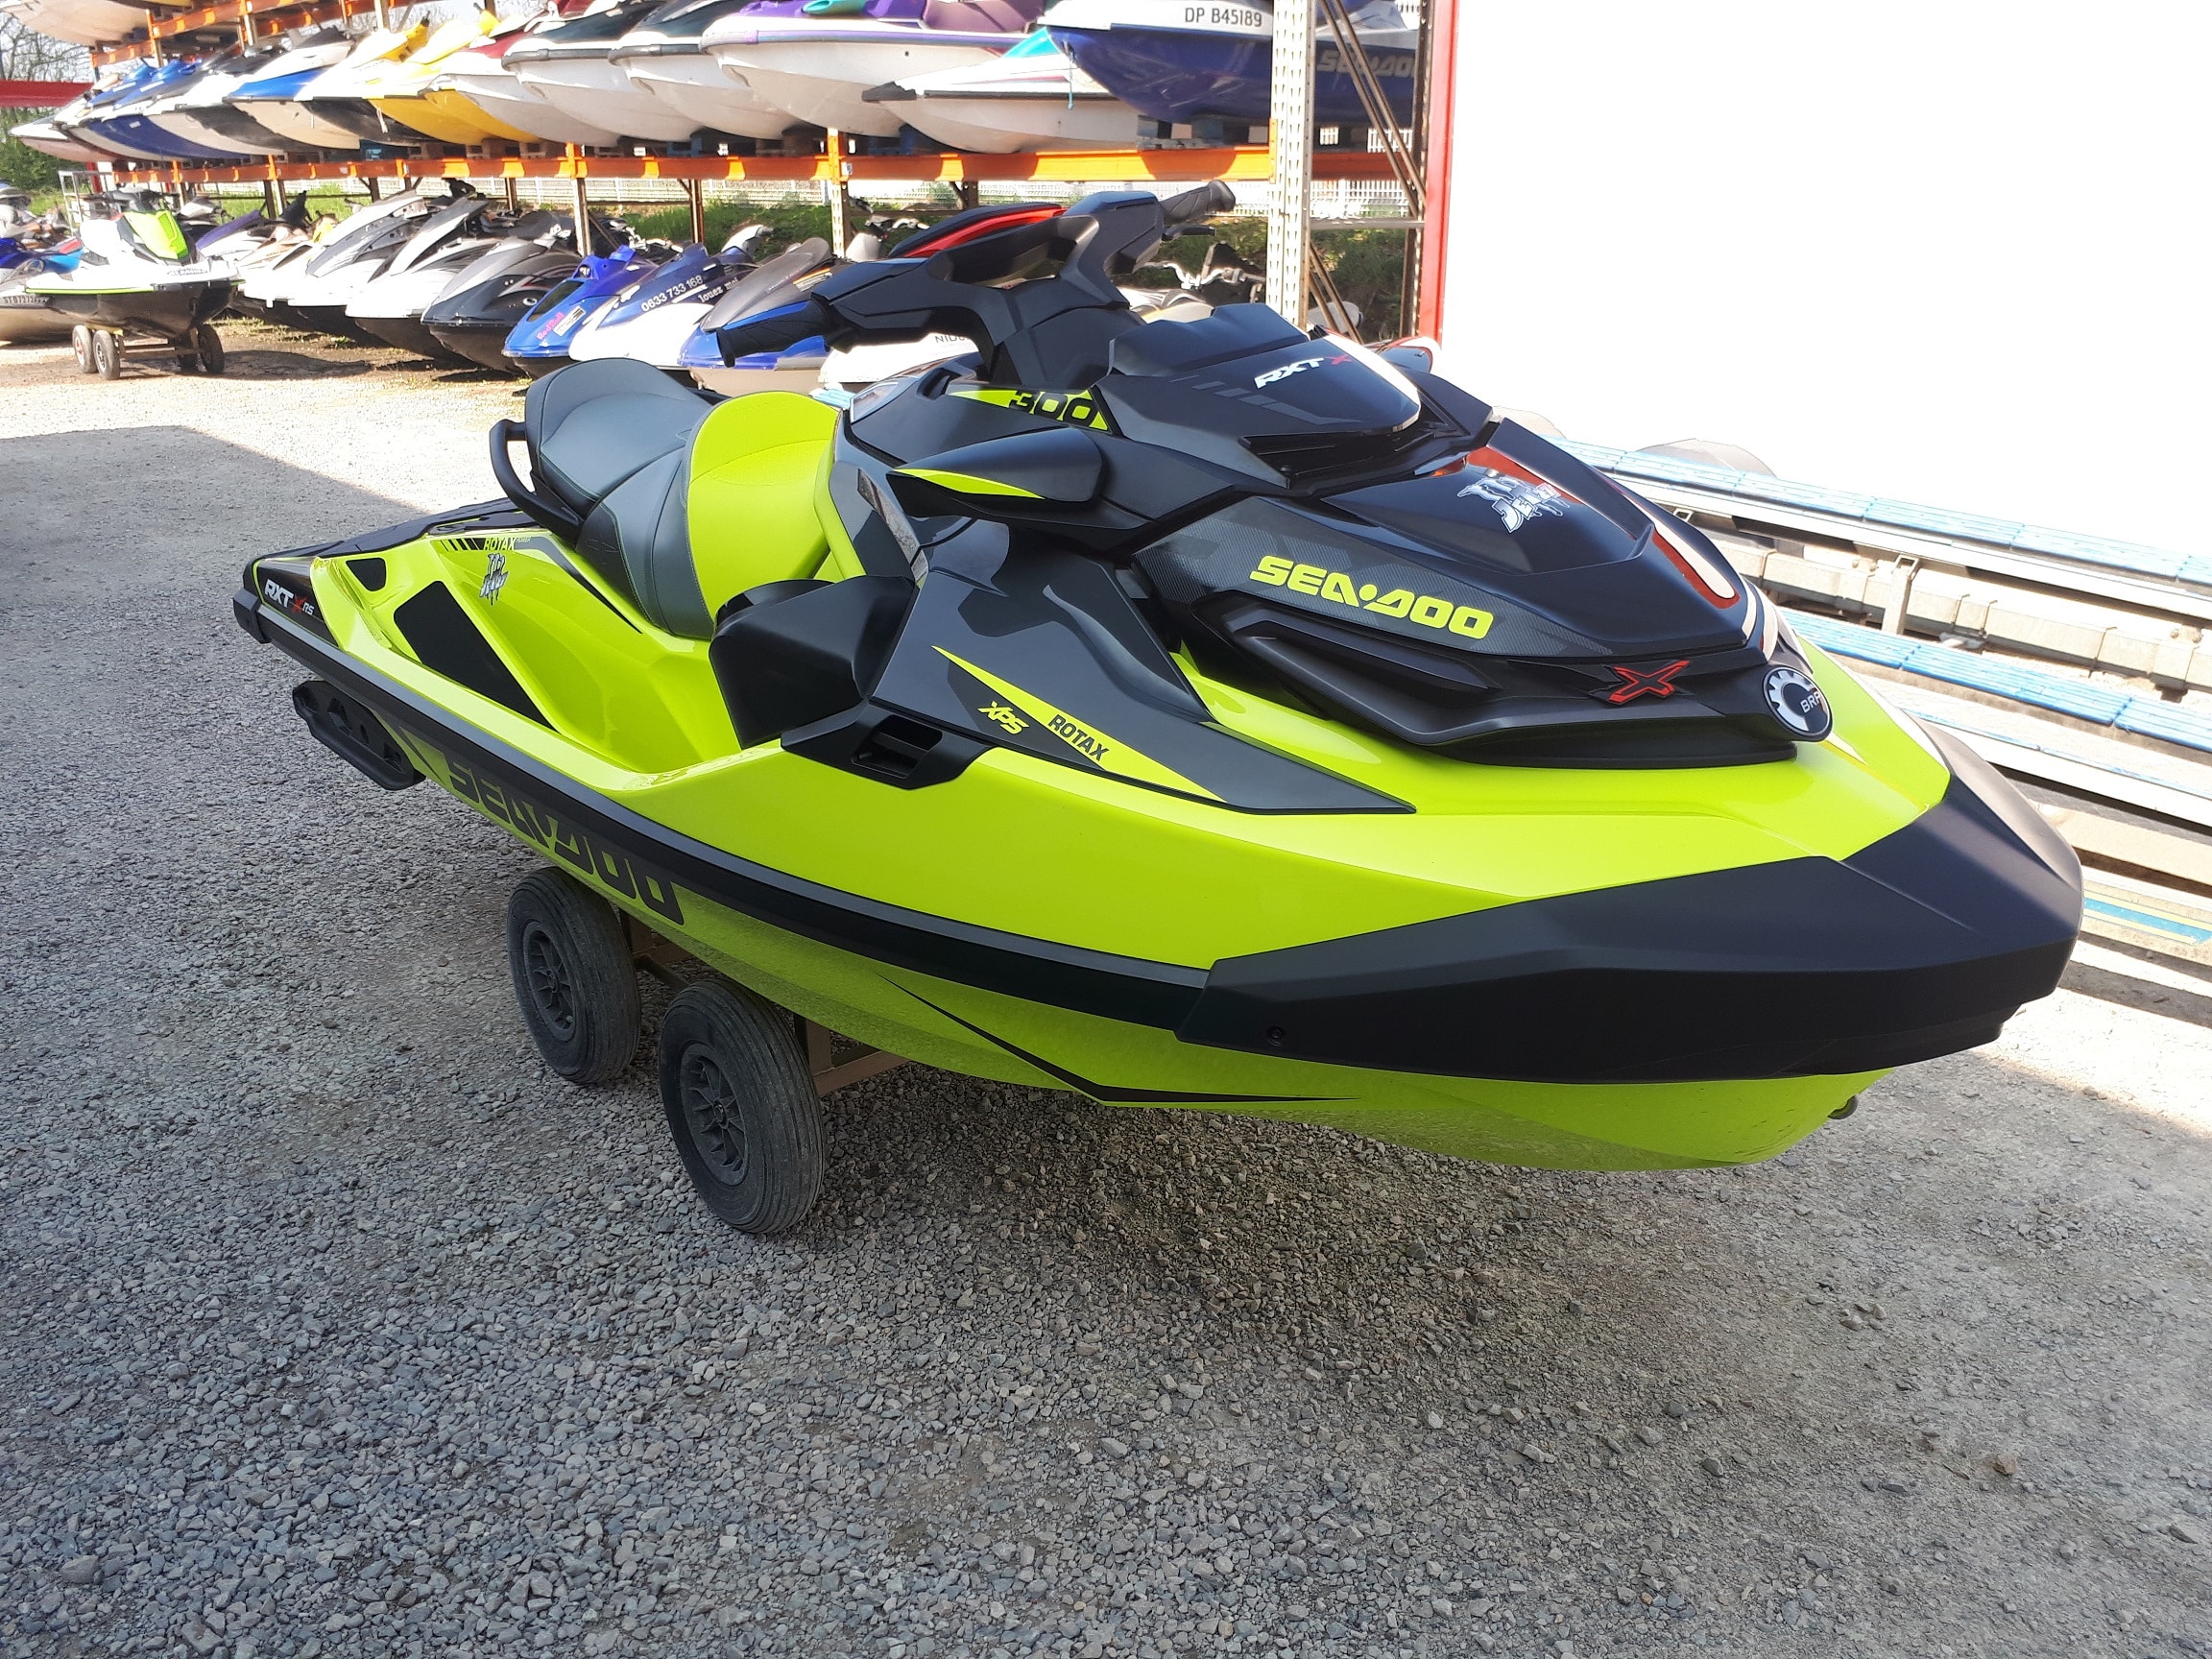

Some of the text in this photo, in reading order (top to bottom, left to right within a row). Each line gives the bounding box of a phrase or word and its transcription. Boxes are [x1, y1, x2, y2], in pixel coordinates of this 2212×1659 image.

[1185, 7, 1262, 28] DP B45189
[640, 275, 704, 312] 0633 733 168
[698, 286, 724, 303] louez
[1254, 357, 1325, 389] RXT
[1008, 388, 1101, 429] 300
[483, 537, 517, 551] ROTAX
[264, 578, 295, 609] RXT
[301, 601, 315, 616] RS
[977, 700, 1030, 734] XPS
[1799, 690, 1821, 714] BRP
[1047, 713, 1110, 761] ROTAX
